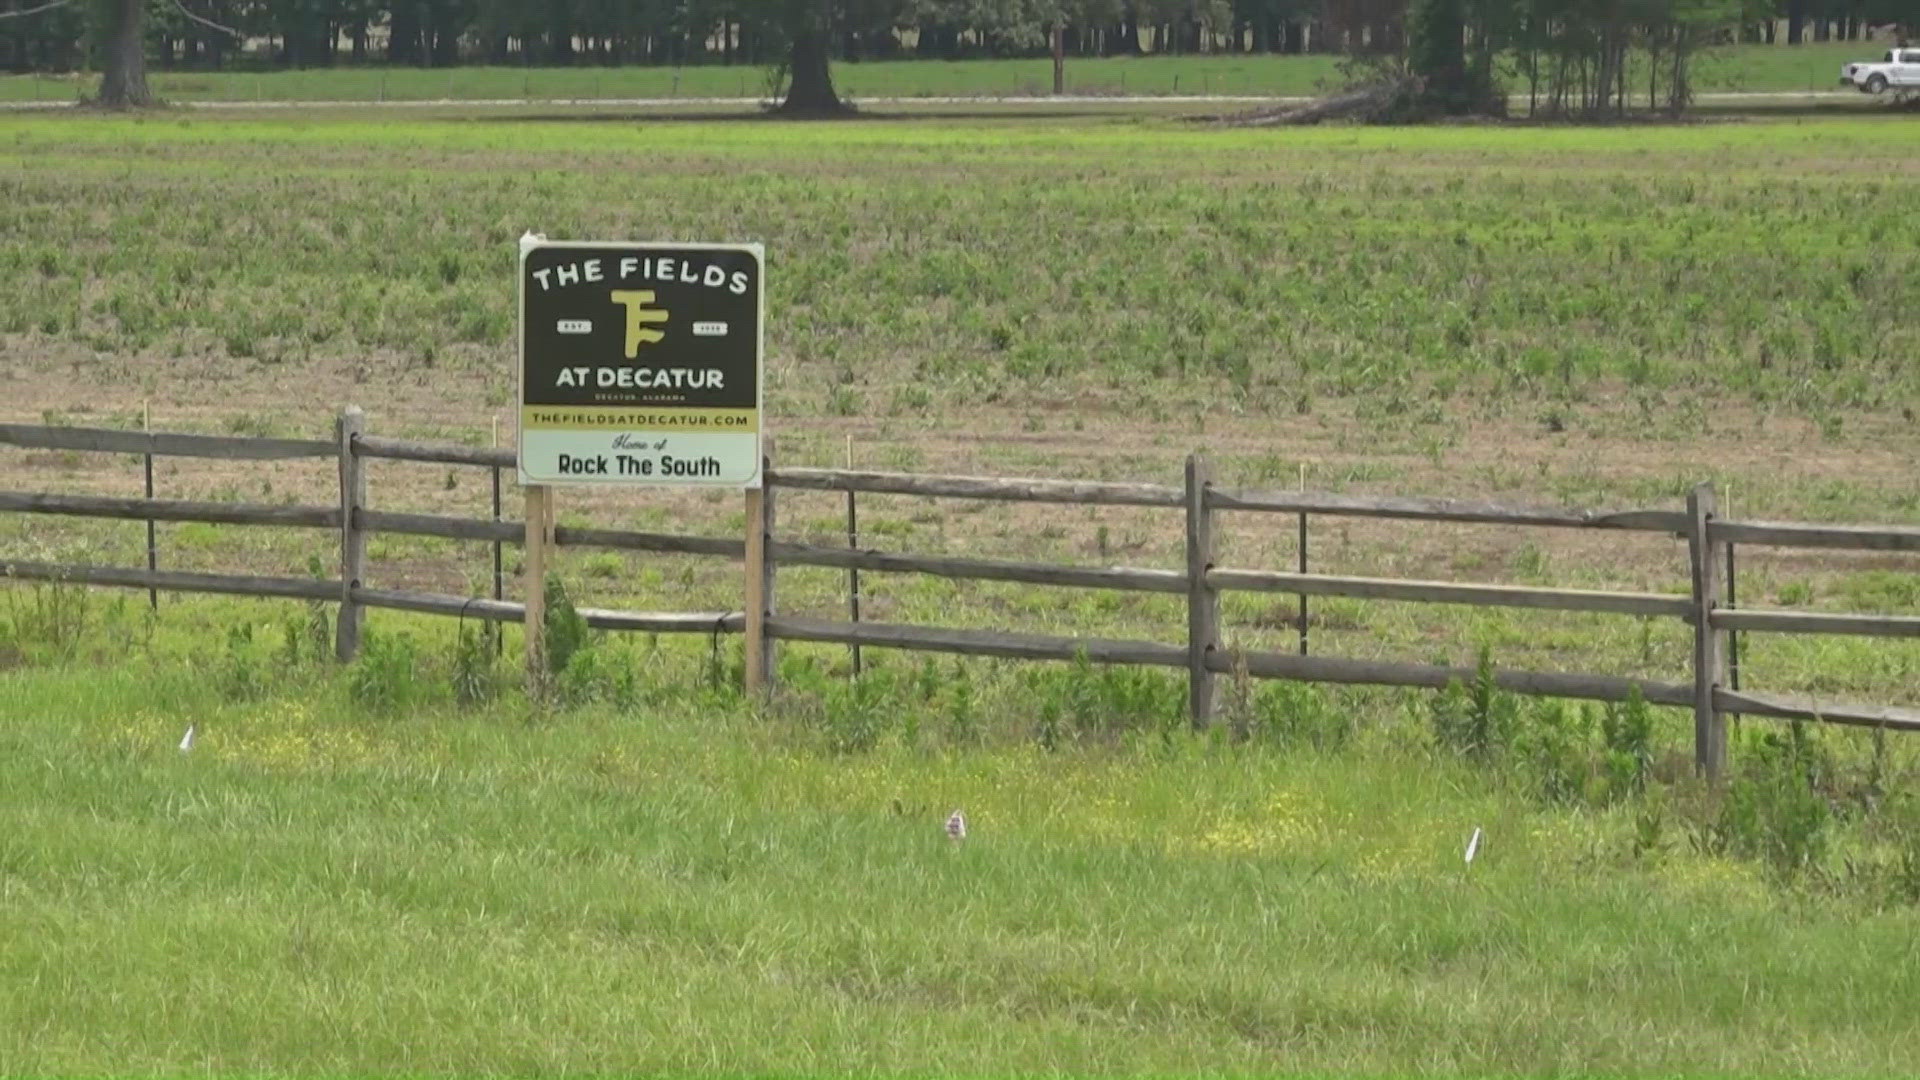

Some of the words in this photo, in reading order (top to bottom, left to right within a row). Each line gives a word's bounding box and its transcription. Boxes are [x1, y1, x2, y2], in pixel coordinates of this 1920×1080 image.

[532, 258, 604, 291] THE
[620, 257, 748, 294] FIELDS
[556, 367, 590, 387] AT
[597, 367, 724, 388] DECATUR
[532, 413, 748, 426] THEFIELDSATDECATUR.COM
[611, 432, 648, 450] Home
[653, 438, 668, 451] of
[558, 454, 608, 475] Rock
[616, 455, 652, 475] The
[661, 456, 720, 476] South
